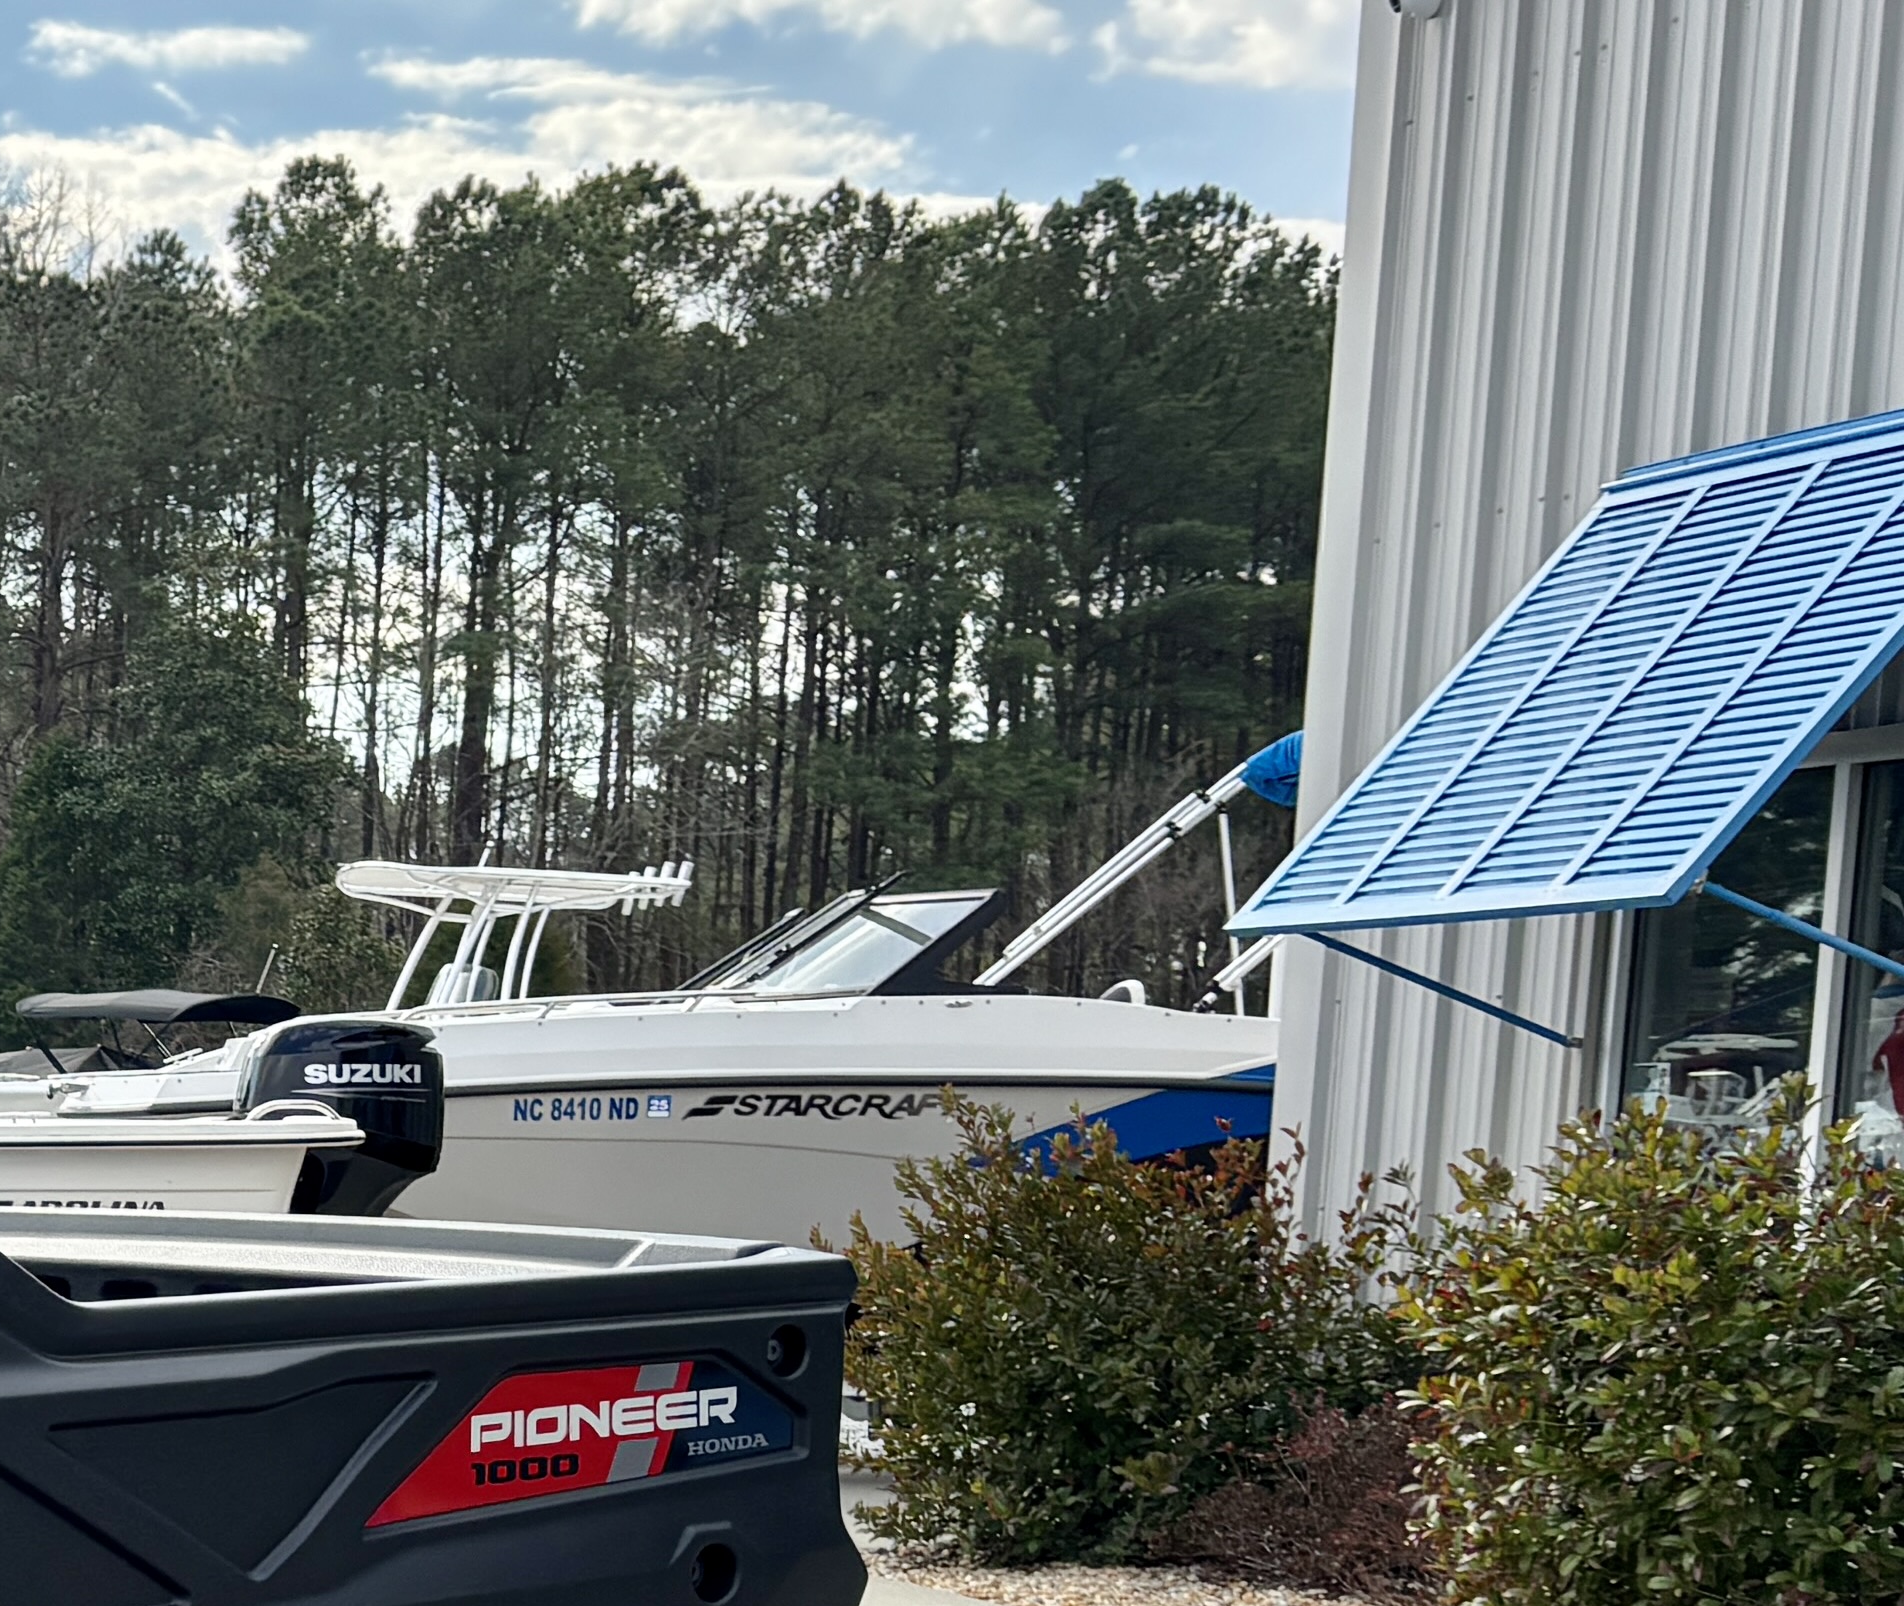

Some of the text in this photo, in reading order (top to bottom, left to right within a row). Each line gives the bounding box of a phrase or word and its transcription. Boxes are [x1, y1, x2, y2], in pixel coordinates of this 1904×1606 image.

[303, 1063, 423, 1085] SUZUKI
[513, 1097, 639, 1121] NC 8410 ND
[470, 1386, 738, 1454] PIONEER
[687, 1433, 769, 1456] HONDA
[471, 1454, 580, 1486] 1000
